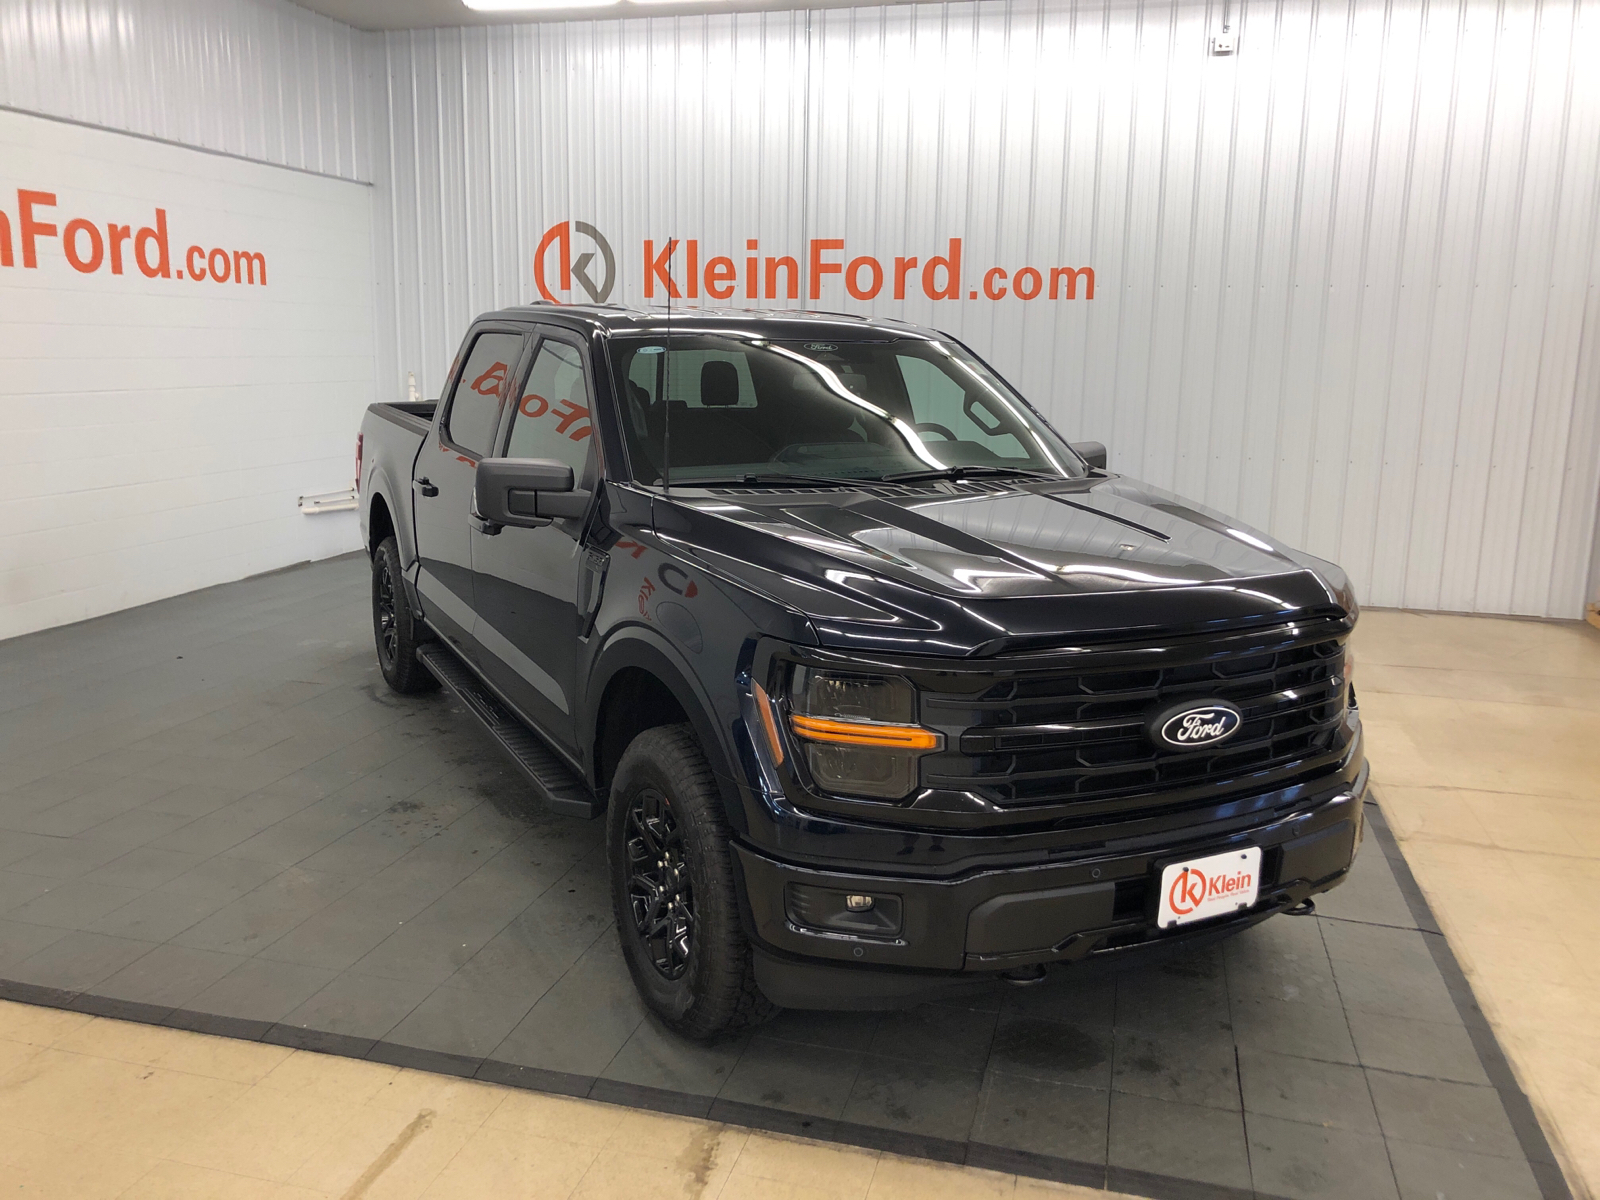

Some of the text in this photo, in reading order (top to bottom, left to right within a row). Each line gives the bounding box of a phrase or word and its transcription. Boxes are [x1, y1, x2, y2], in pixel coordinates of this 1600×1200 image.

[643, 237, 1095, 301] KleinFord.com
[1177, 712, 1227, 741] Ford
[1208, 870, 1252, 897] Klein
